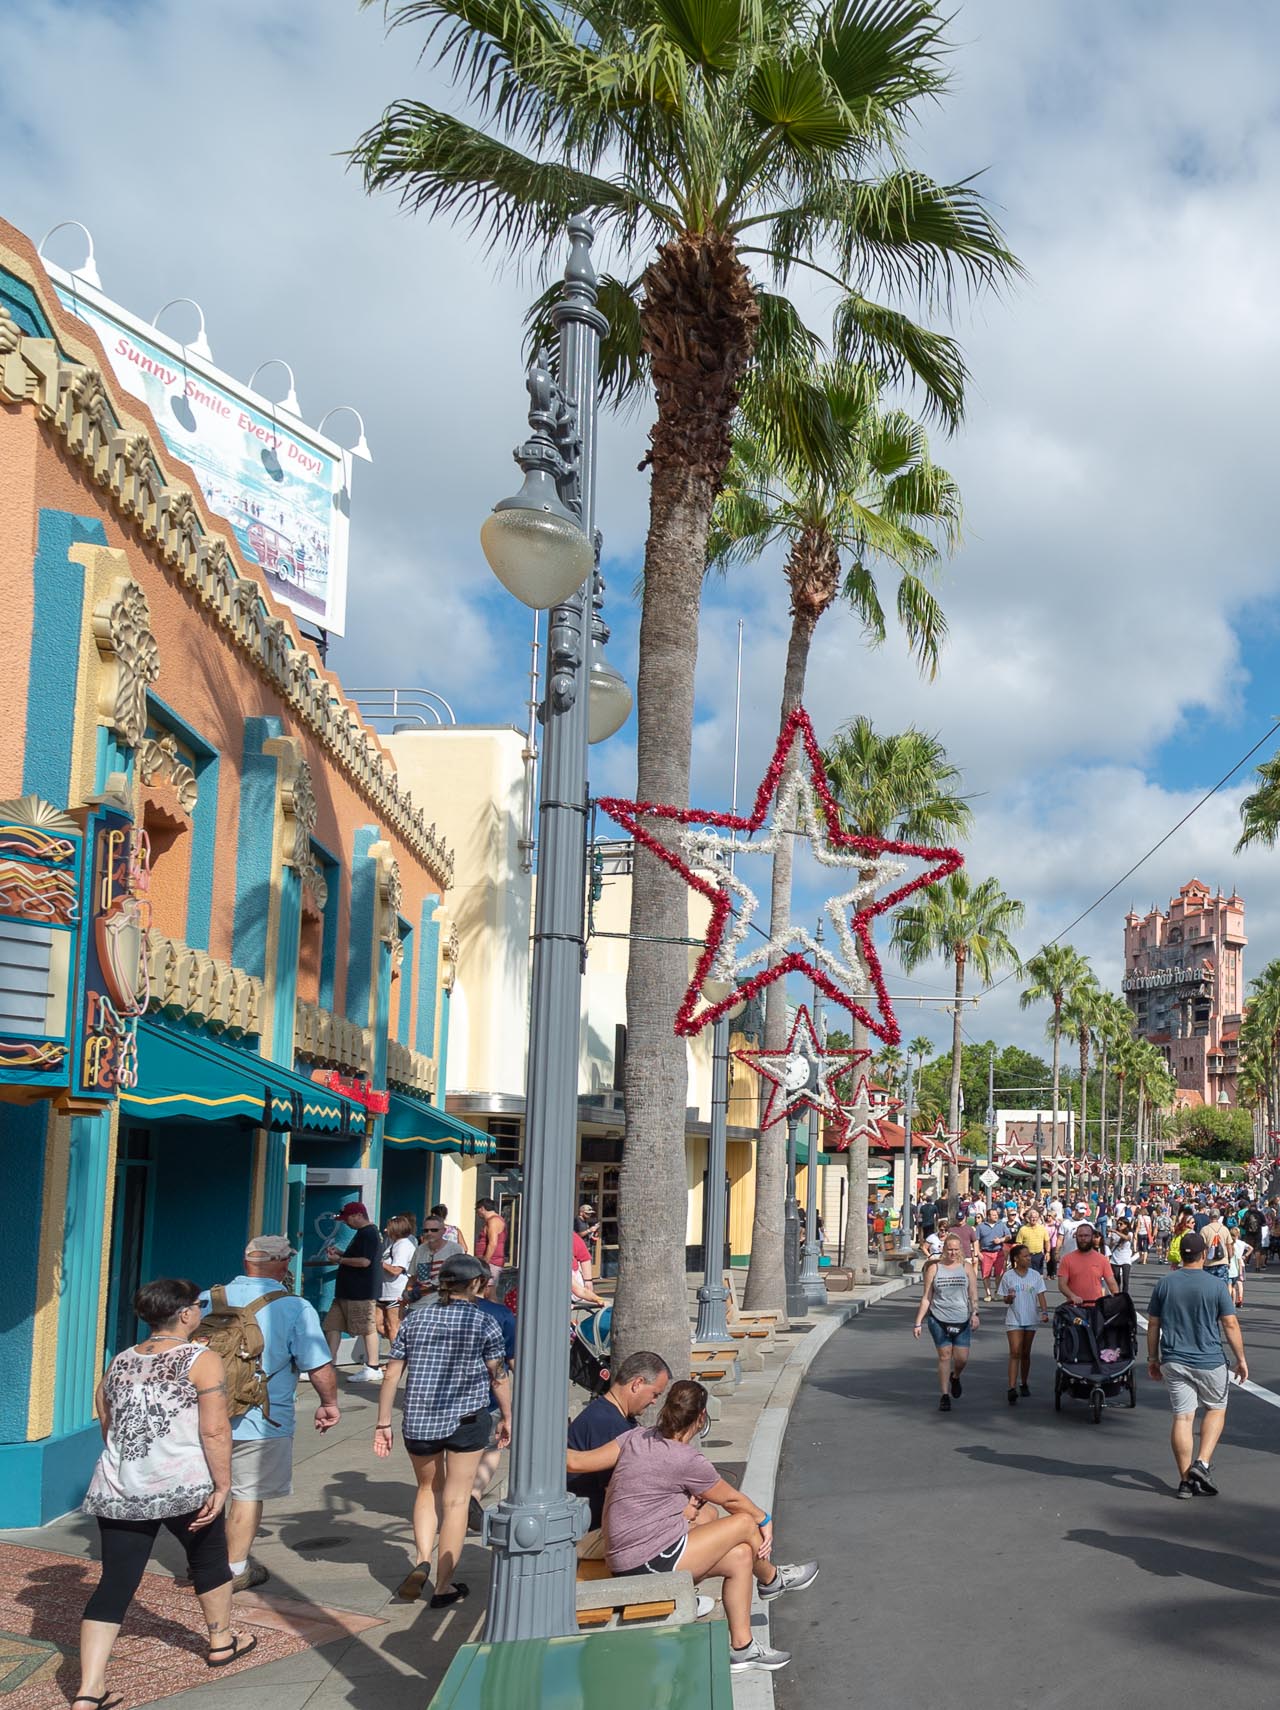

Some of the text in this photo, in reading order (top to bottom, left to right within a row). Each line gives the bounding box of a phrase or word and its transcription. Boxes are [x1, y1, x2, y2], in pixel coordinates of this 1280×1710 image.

[114, 338, 322, 475] Sunny Smile Every Day!
[1121, 968, 1204, 990] HOLLYWOOD TOWER
